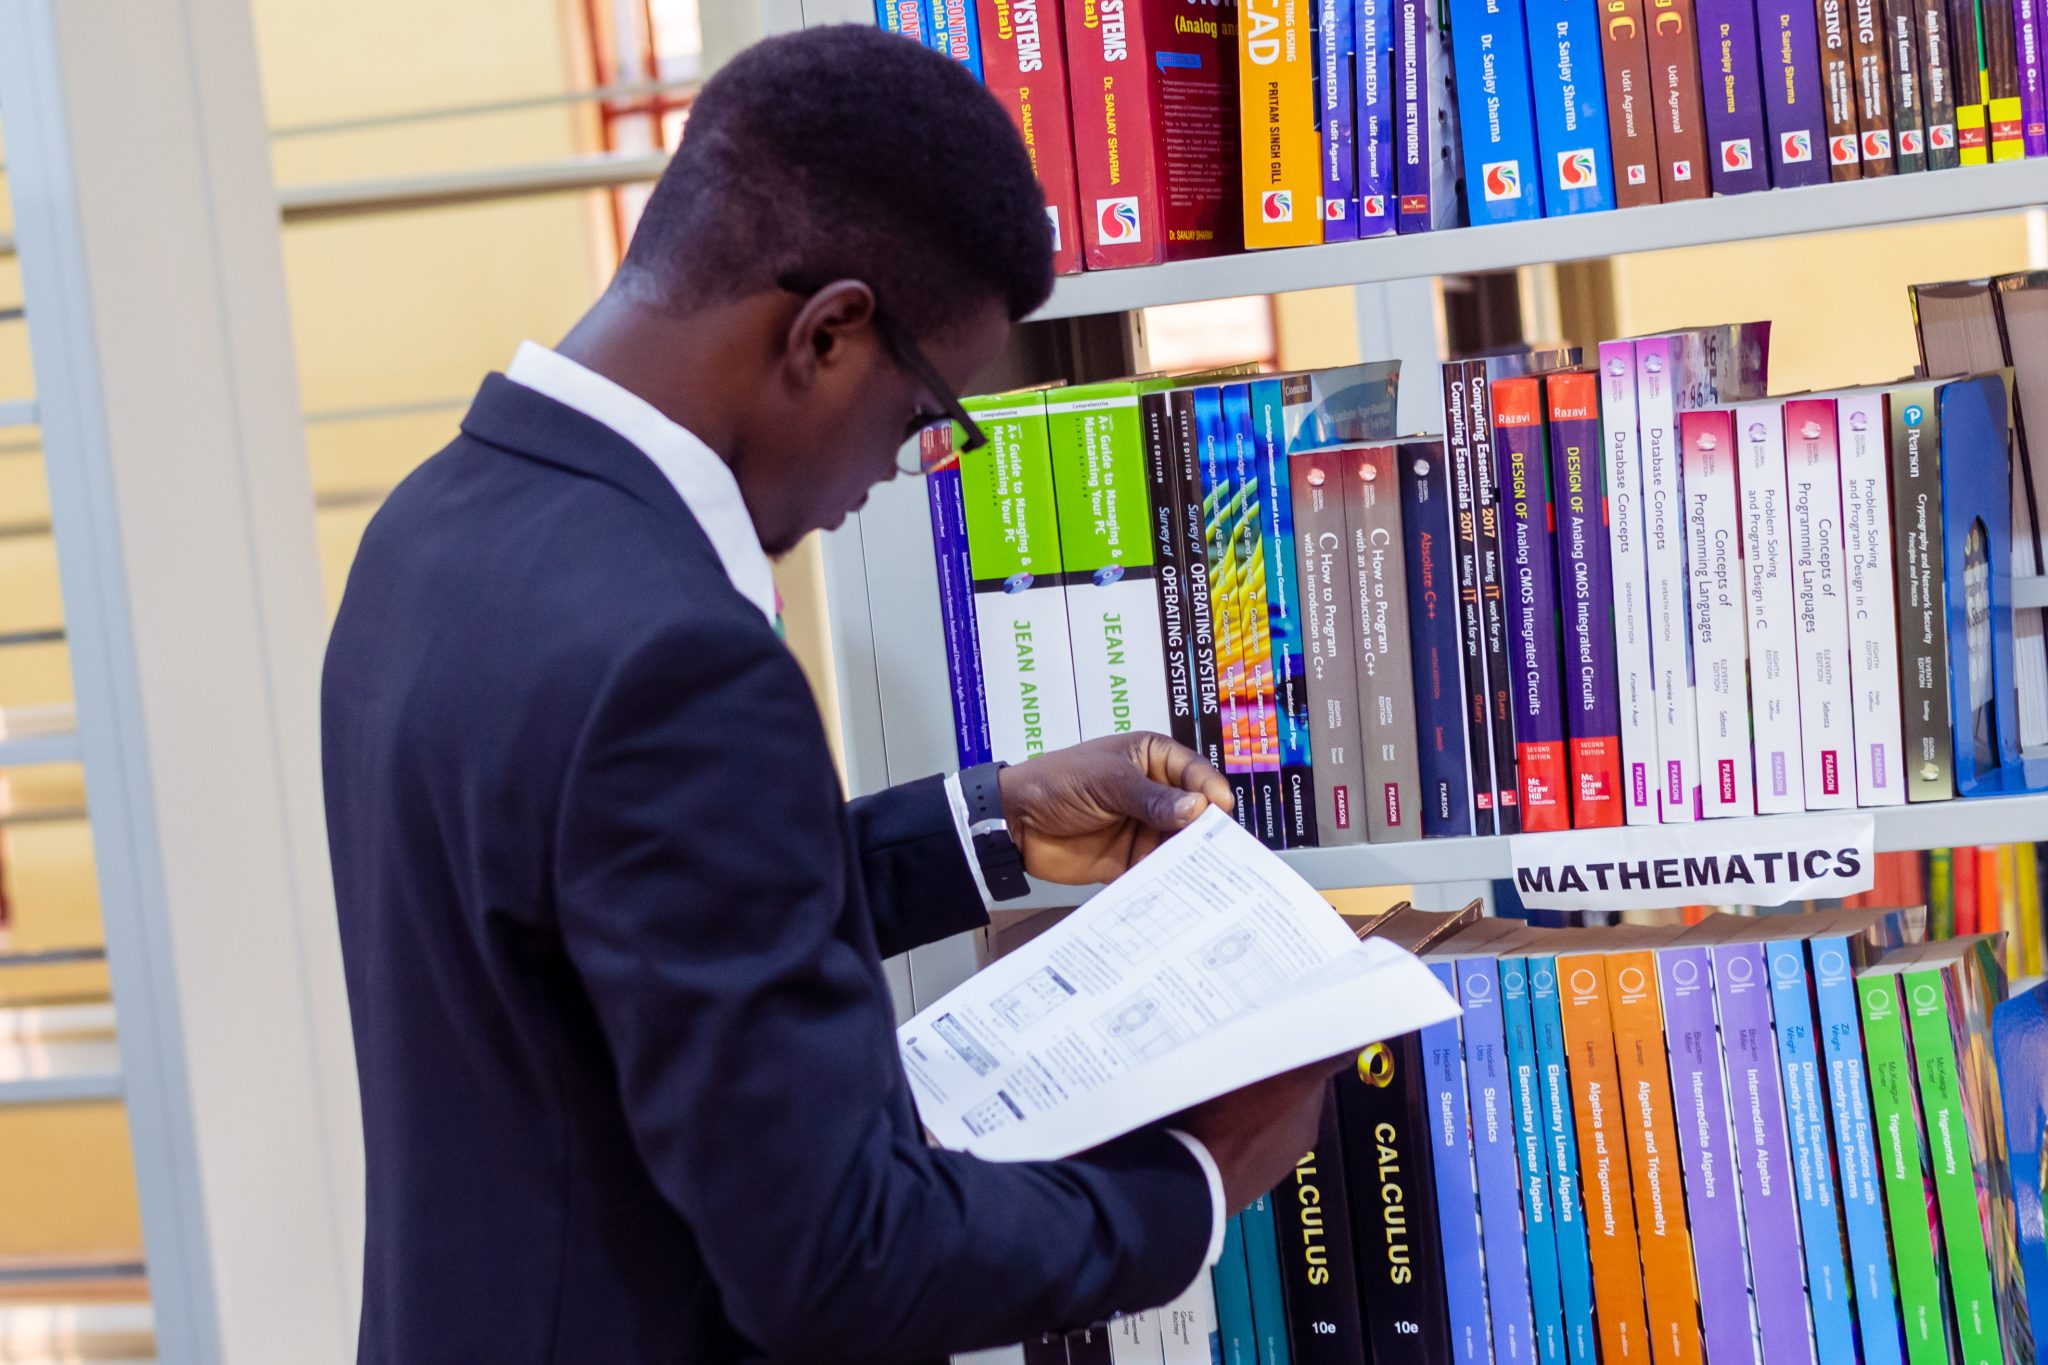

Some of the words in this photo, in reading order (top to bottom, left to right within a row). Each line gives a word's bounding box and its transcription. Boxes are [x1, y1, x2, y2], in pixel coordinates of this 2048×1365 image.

[1175, 15, 1217, 38] (Analog
[1481, 34, 1492, 50] Dr.
[1557, 21, 1568, 38] Dr.
[1609, 16, 1636, 40] C
[1656, 12, 1683, 36] C
[1720, 24, 1729, 38] Dr.
[2023, 24, 2035, 64] USING
[1287, 32, 1296, 62] USING
[1365, 19, 1377, 105] MULTIMEDIA
[1404, 4, 1417, 99] COMMUNICATION
[1557, 42, 1571, 82] Sanjay
[1722, 40, 1731, 73] Sanjay
[1103, 77, 1113, 91] Dr.
[1325, 27, 1337, 109] MULTIMEDIA
[1482, 54, 1497, 94] Sanjay
[1621, 70, 1631, 91] Udit
[2028, 68, 2036, 92] C++
[1020, 87, 1029, 102] Dr.
[1104, 93, 1117, 135] SANJAY
[1269, 82, 1278, 123] PRITAM
[1562, 85, 1576, 131] Sharma
[1725, 75, 1735, 113] Sharma
[1021, 103, 1034, 145] SANJAY
[1330, 120, 1338, 139] Udit
[1407, 103, 1419, 165] NETWORKS
[1487, 97, 1500, 142] Sharma
[1622, 95, 1637, 137] Agrawal
[1108, 138, 1120, 185] SHARMA
[1270, 127, 1280, 158] SINGH
[1272, 162, 1281, 184] GILL
[1151, 413, 1159, 441] SIXTH
[1451, 381, 1463, 445] Computing
[1472, 377, 1484, 441] Computing
[1499, 413, 1530, 424] Razavi
[1554, 407, 1587, 418] Razavi
[1007, 425, 1017, 440] A+
[994, 425, 1008, 495] Maintaining
[1009, 443, 1020, 477] Guide
[1154, 445, 1162, 483] EDITION
[1615, 432, 1625, 488] Database
[1909, 430, 1920, 478] Pearson
[1013, 481, 1022, 493] to
[1456, 448, 1469, 509] Essentials
[1477, 444, 1490, 506] Essentials
[1512, 453, 1526, 498] DESIGN
[1001, 498, 1011, 526] Your
[1515, 503, 1527, 519] OF
[1749, 490, 1758, 509] and
[1765, 489, 1775, 536] Problem
[1004, 529, 1015, 542] PC
[1016, 498, 1028, 552] Managing
[1159, 507, 1169, 543] Survey
[1188, 504, 1198, 539] Survey
[1193, 544, 1202, 553] of
[1320, 533, 1338, 550] C
[1460, 513, 1473, 542] 2017
[1482, 508, 1495, 538] 2017
[1618, 494, 1629, 553] Concepts
[1692, 493, 1707, 577] Programming
[1749, 514, 1762, 562] Program
[1918, 494, 1928, 549] Cryptography
[1022, 557, 1031, 565] &
[1163, 544, 1173, 556] of
[1303, 533, 1315, 557] with
[1420, 532, 1432, 587] Absolute
[1517, 523, 1531, 565] Analog
[1714, 529, 1728, 588] Concepts
[1767, 539, 1777, 578] Solving
[1306, 560, 1314, 572] an
[1321, 554, 1333, 584] How
[1463, 555, 1472, 587] Making
[1520, 568, 1534, 604] CMOS
[1752, 565, 1763, 604] Design
[1162, 566, 1182, 646] OPERATING
[1191, 564, 1212, 646] OPERATING
[1307, 576, 1320, 640] introduction
[1324, 586, 1331, 601] to
[1424, 591, 1436, 619] C++
[1463, 590, 1476, 603] IT
[1720, 590, 1732, 607] of
[1922, 566, 1930, 610] Network
[1323, 604, 1336, 657] Program
[1466, 604, 1475, 623] work
[1468, 624, 1476, 637] for
[1698, 581, 1712, 643] Languages
[1756, 607, 1763, 616] in
[1757, 620, 1767, 629] C
[1922, 611, 1932, 644] Security
[1014, 620, 1034, 672] JEAN
[1104, 613, 1124, 665] JEAN
[1313, 643, 1320, 652] to
[1523, 607, 1538, 668] Integrated
[1169, 651, 1189, 716] SYSTEMS
[1198, 650, 1218, 714] SYSTEMS
[1314, 656, 1324, 680] C++
[1109, 676, 1131, 732] ANDR
[1528, 672, 1539, 715] Circuits
[1440, 783, 1448, 818] PEARSON
[1528, 778, 1539, 786] Mc
[1722, 763, 1731, 800] PEARSON
[1263, 786, 1274, 838] CAMBRIDGE
[1292, 774, 1304, 836] CAMBRIDGE
[1337, 790, 1345, 825] PEARSON
[1517, 847, 1861, 894] MATHEMATICS
[1484, 1087, 1497, 1143] Statistics
[1519, 1065, 1534, 1133] Elementary
[1589, 1082, 1602, 1128] Algebra
[1441, 1092, 1454, 1147] Statistics
[1692, 1071, 1709, 1147] Intermediate
[1701, 1151, 1715, 1198] Algebra
[1802, 1062, 1818, 1123] Differential
[1810, 1125, 1823, 1181] Equations
[1817, 1181, 1829, 1207] with
[1524, 1136, 1537, 1174] Linear
[1595, 1131, 1604, 1155] and
[1889, 1113, 1905, 1180] Trigonometry
[1939, 1108, 1955, 1175] Trigonometry
[1797, 1147, 1812, 1201] Problems
[1375, 1123, 1411, 1284] CALCULUS
[1530, 1176, 1542, 1222] Algebra
[1597, 1158, 1615, 1237] Trigonometry
[1312, 1322, 1336, 1334] 10e
[1395, 1321, 1419, 1334] 10e
